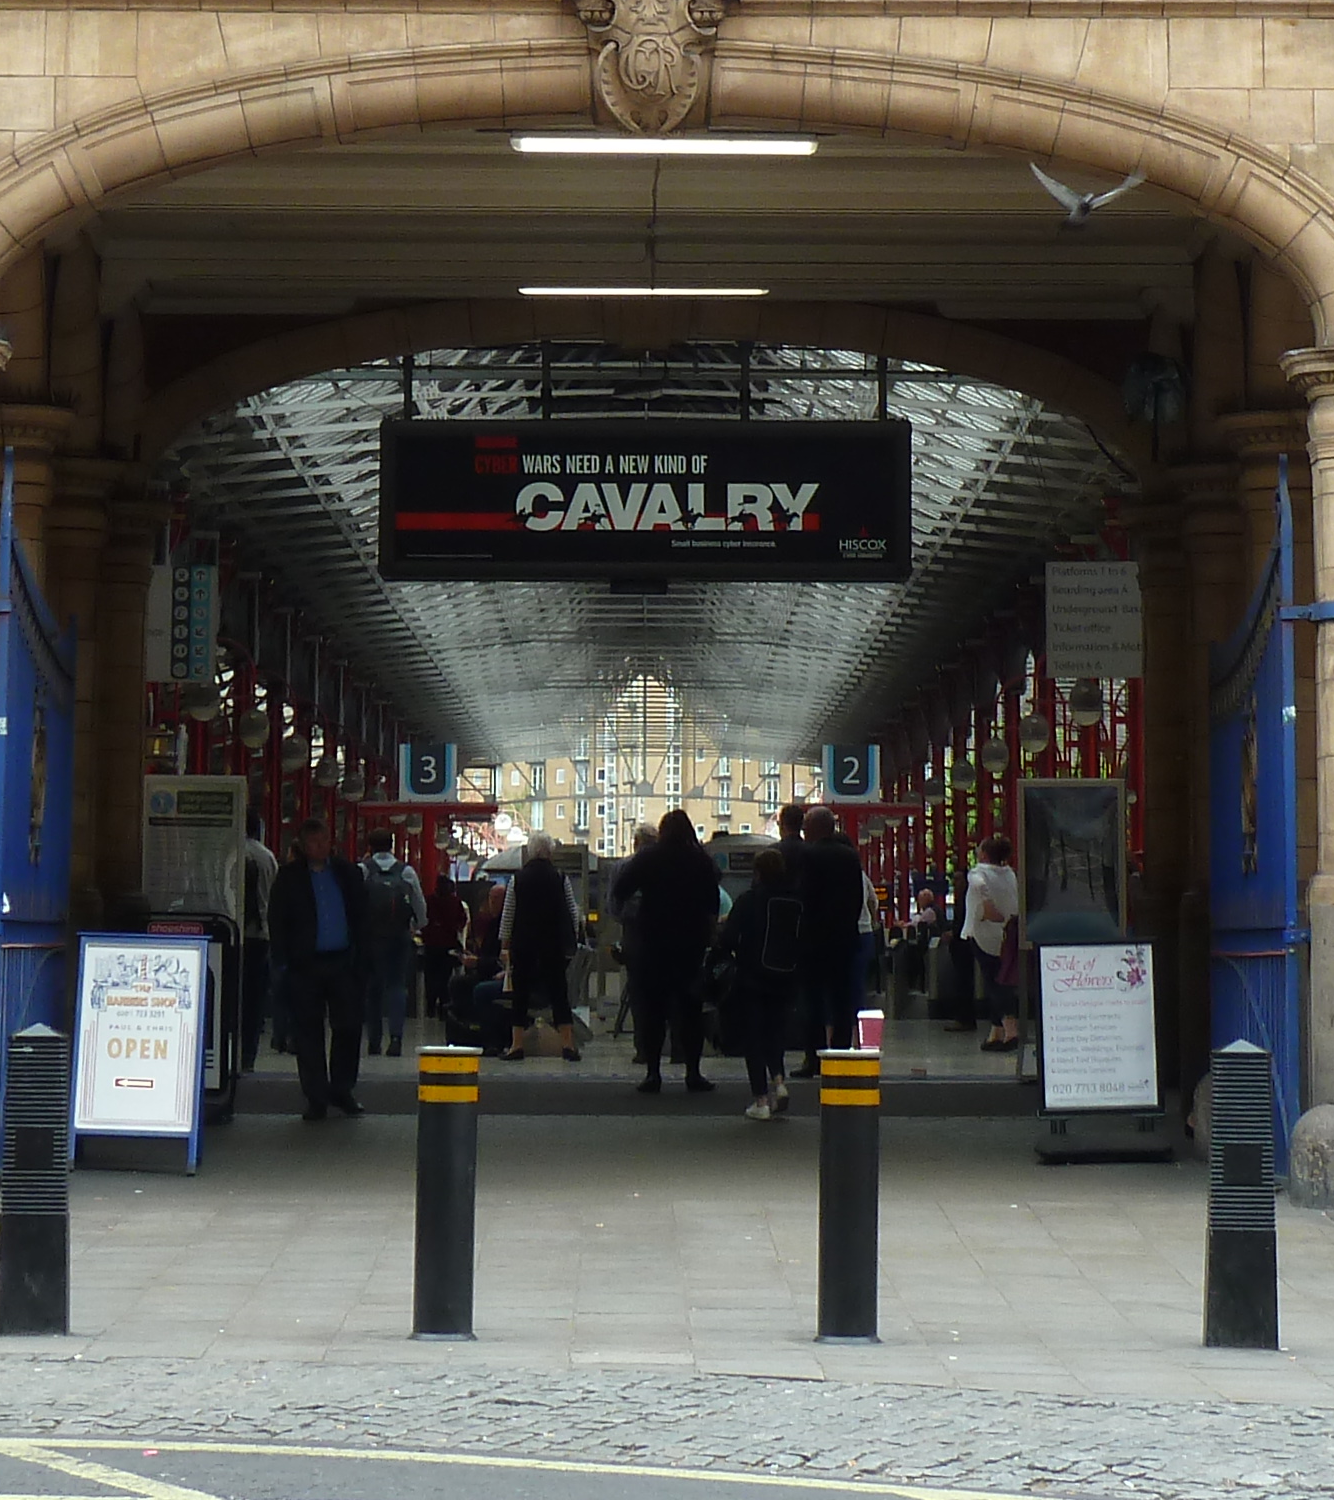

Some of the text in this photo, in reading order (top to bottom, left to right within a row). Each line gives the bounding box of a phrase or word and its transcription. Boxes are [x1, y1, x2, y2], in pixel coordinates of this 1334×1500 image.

[475, 454, 709, 475] CYBER WARS NEED A NEW KIND OF
[516, 481, 820, 532] CAVALRY
[838, 539, 888, 551] HISCOX
[419, 755, 438, 784] 3
[842, 755, 861, 785] 2
[107, 1037, 169, 1060] OPEN
